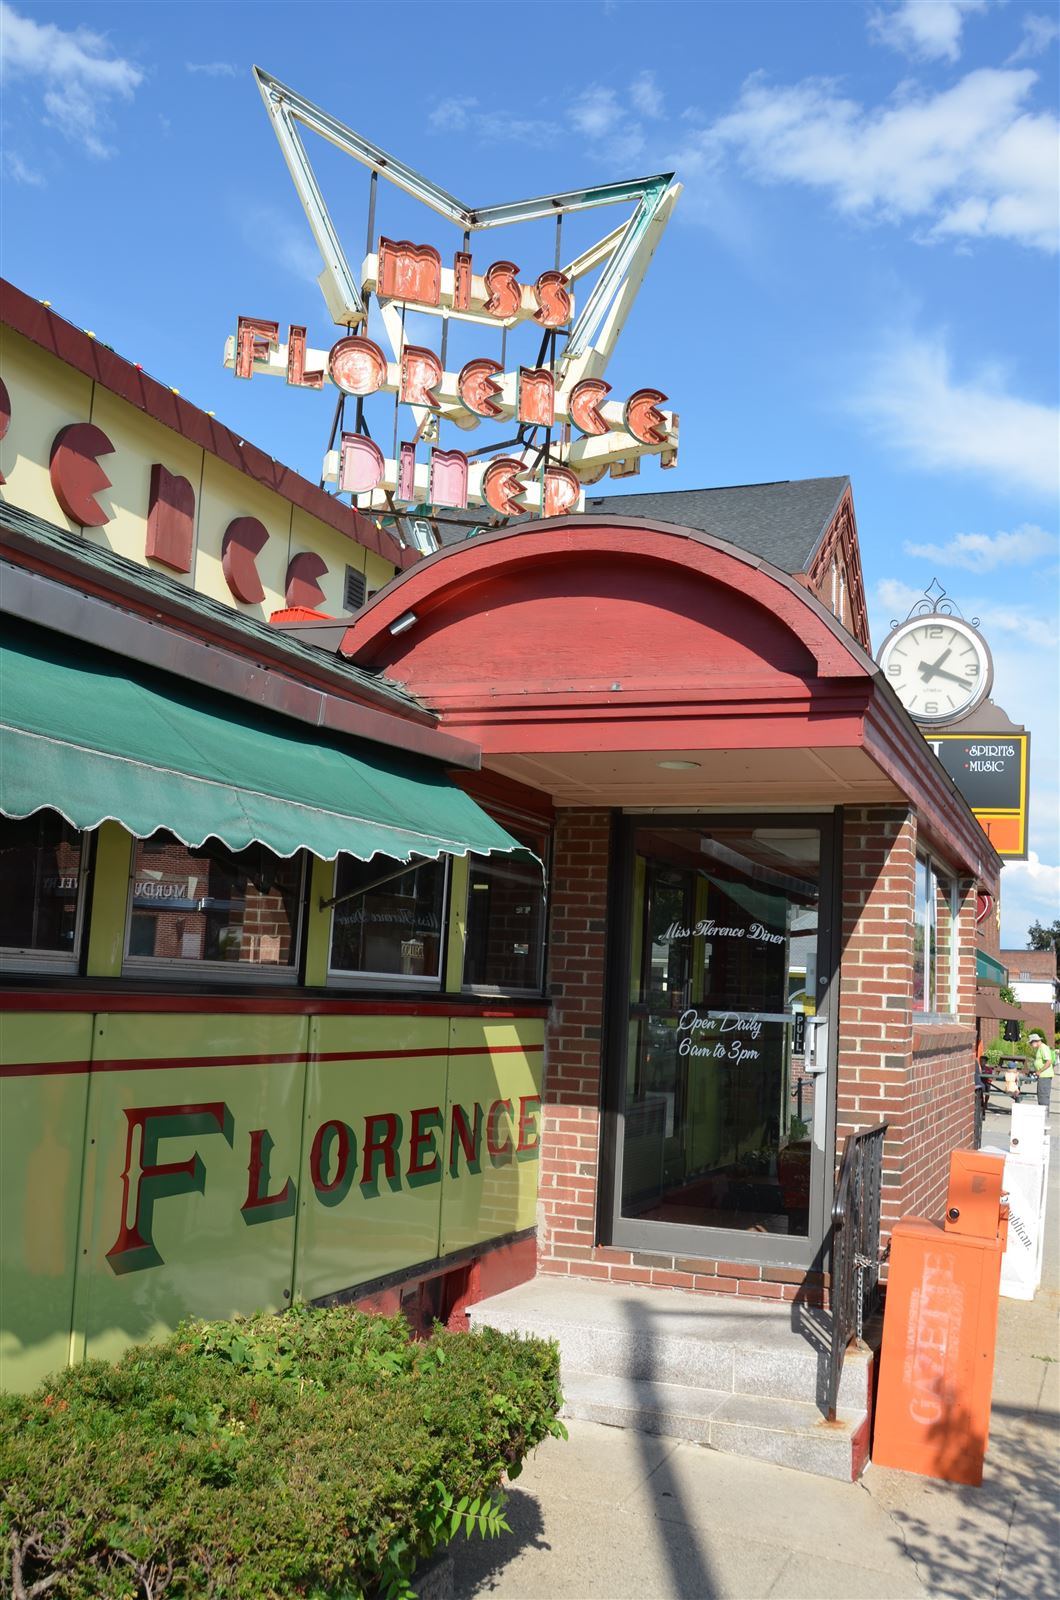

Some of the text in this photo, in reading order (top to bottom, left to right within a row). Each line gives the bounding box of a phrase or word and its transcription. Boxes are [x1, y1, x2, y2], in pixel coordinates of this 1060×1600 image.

[376, 235, 572, 329] MISS
[234, 315, 669, 446] FLORENCE
[338, 431, 581, 518] DINER
[0, 376, 336, 610] ENCE
[924, 626, 943, 639] 12
[887, 664, 902, 677] 9
[965, 664, 979, 676] 3
[924, 701, 939, 714] 6
[969, 745, 1015, 757] SPIRITS
[969, 760, 1005, 772] MUSIC
[658, 919, 787, 945] Miss Florence Diner
[677, 1009, 762, 1040] Open Daily
[796, 1016, 804, 1052] PULL
[678, 1037, 760, 1066] 6am to 3pm
[105, 1094, 542, 1276] FLORENCE
[909, 1252, 955, 1426] GAZETTE
